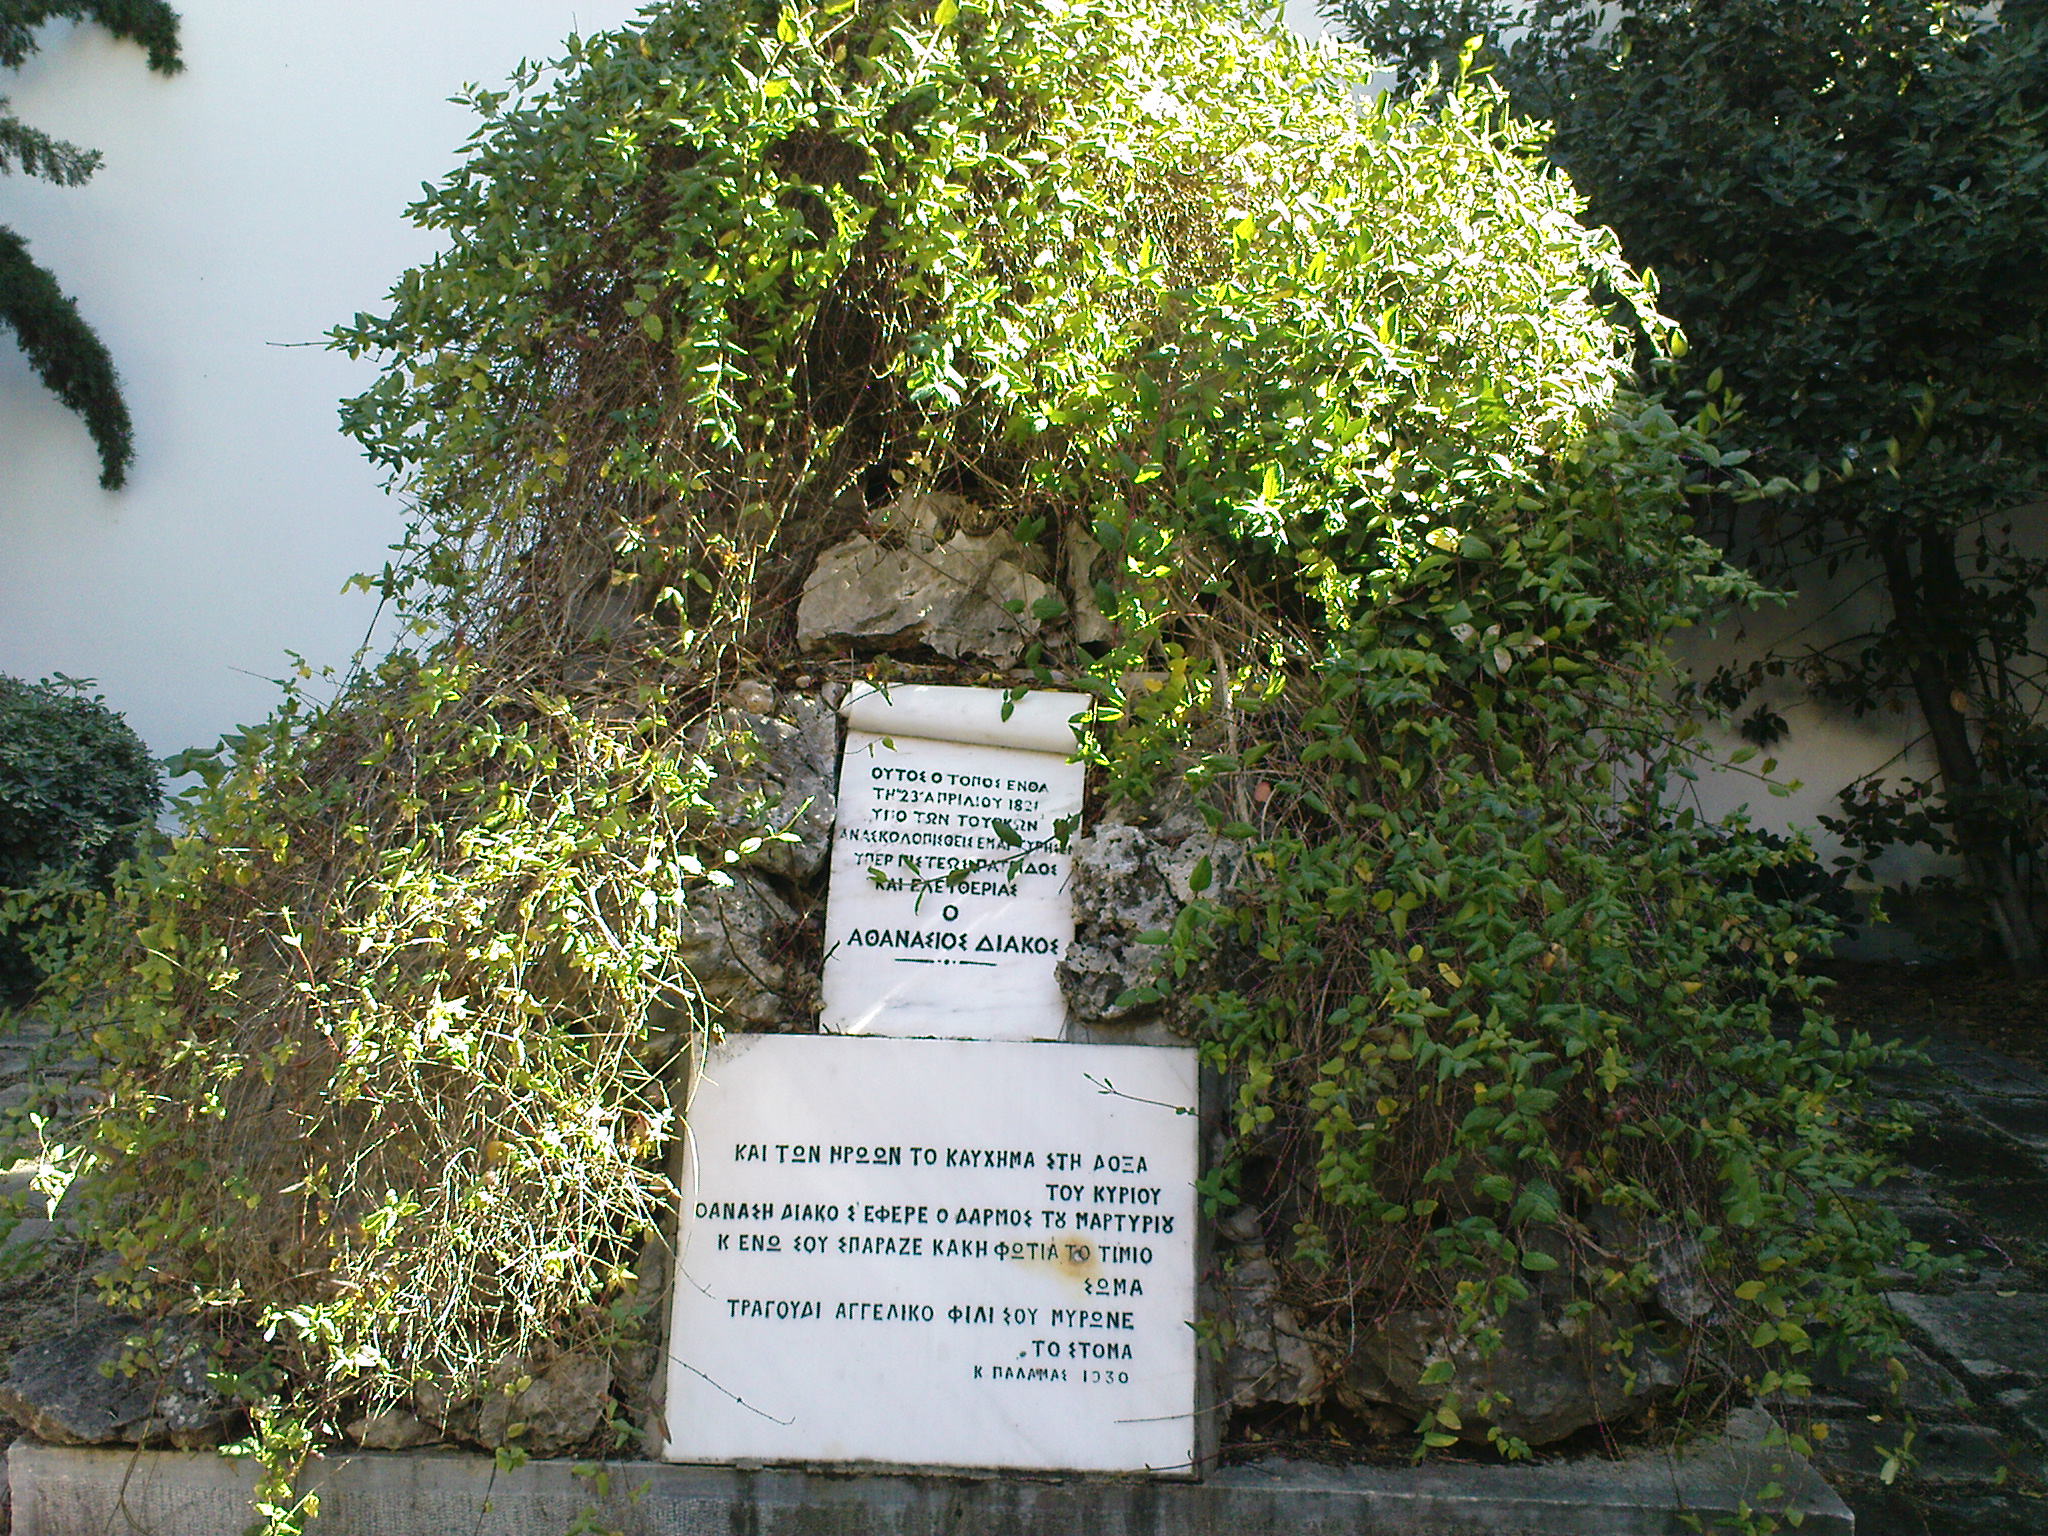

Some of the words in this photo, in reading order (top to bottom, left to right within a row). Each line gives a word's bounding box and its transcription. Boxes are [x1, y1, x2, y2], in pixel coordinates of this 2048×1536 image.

[871, 767, 927, 783] ΟΥΤΟΣ
[931, 772, 943, 784] Ο
[947, 774, 1000, 789] ΤΟΠΟΣ
[1008, 780, 1049, 793] ΕΝΘΑ
[914, 811, 950, 825] ΤΩΝ
[854, 853, 898, 865] ΥΠΕΡ
[943, 905, 959, 921] Ο
[848, 929, 967, 951] ΑΘΑΝΑΣΙΟΣ
[975, 935, 1058, 955] ΔΙΑΚΟΣ
[735, 1144, 768, 1162] ΚΑΙ
[776, 1145, 820, 1163] ΤΩΝ
[830, 1145, 901, 1165] ΗΡΩΩΝ
[910, 1147, 937, 1166] ΤΟ
[946, 1148, 1035, 1169] ΚΑΥΧΗΜΑ
[1046, 1153, 1081, 1171] ΣΤΗ
[1094, 1155, 1148, 1173] ΔΟΞΑ
[1046, 1184, 1084, 1202] ΤΟΥ
[1094, 1186, 1161, 1205] ΚΥΡΙΟΥ
[781, 1204, 839, 1222] ΔΙΑΚΟ
[937, 1208, 948, 1223] Ο
[956, 1209, 1032, 1227] ΔΑΡΜΟΣ
[718, 1234, 730, 1251] Κ
[739, 1235, 782, 1252] ΕΝΩ
[793, 1236, 828, 1254] ΣΟΥ
[839, 1237, 923, 1256] ΣΠΑΡΑΖΕ
[933, 1239, 987, 1257] ΚΑΚΗ
[994, 1242, 1058, 1260] ΦΩΤΙΑ
[1065, 1244, 1090, 1262] ΤΟ
[1099, 1245, 1153, 1264] ΤΙΜΙΟ
[1084, 1278, 1143, 1296] ΣΩΜΑ
[727, 1299, 821, 1320] ΤΡΑΓΟΥΔΙ
[836, 1302, 934, 1322] ΑΓΓΕΛΙΚΟ
[948, 1306, 994, 1324] ΦΙΛΙ
[1003, 1307, 1038, 1326] ΣΟΥ
[1052, 1309, 1134, 1330] ΜΥΡΩΝΕ
[1032, 1340, 1060, 1357] ΤΟ
[1069, 1341, 1132, 1359] ΣΤΟΜΑ
